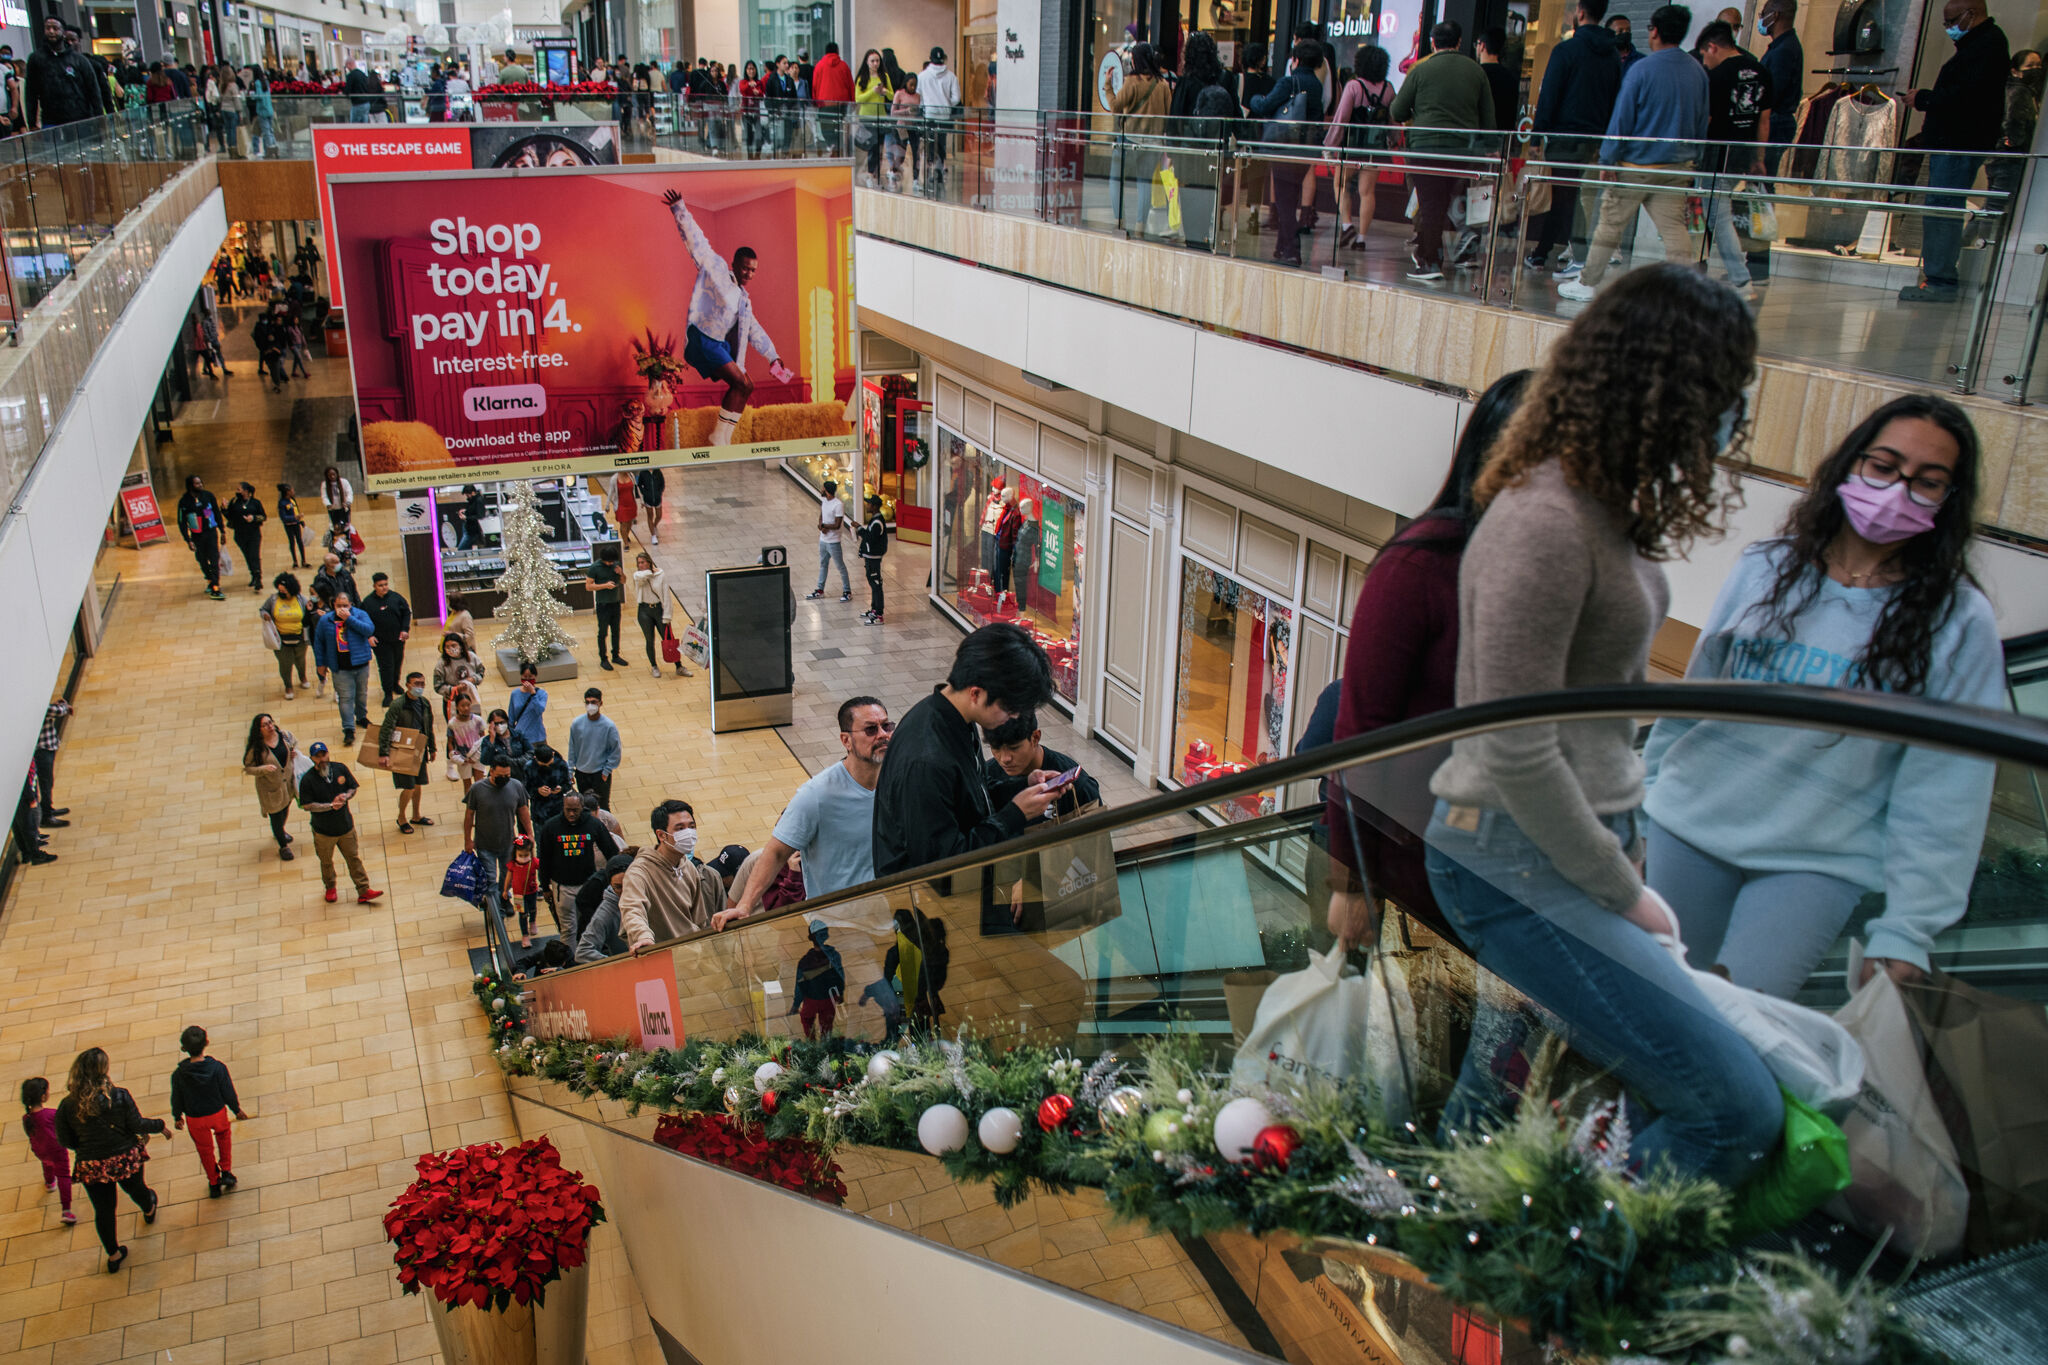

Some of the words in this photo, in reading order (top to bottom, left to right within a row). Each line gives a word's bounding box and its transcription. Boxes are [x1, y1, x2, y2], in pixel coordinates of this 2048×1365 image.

[341, 143, 369, 156] THE
[371, 143, 423, 155] ESCAPE
[425, 142, 462, 154] GAME
[430, 216, 541, 259] Shop
[427, 257, 558, 300] today,
[412, 309, 489, 350] pay
[497, 299, 536, 337] in
[543, 298, 582, 334] 4.
[433, 350, 569, 375] Interest-free.
[472, 395, 538, 412] Klarna.
[444, 433, 514, 450] Download
[517, 431, 541, 445] the
[545, 430, 571, 445] app
[692, 451, 710, 460] VANS
[751, 446, 781, 454] EXPRESS
[532, 464, 572, 473] SEPHORA
[629, 456, 649, 465] Locker
[375, 476, 407, 486] Available
[408, 475, 415, 483] at
[417, 473, 437, 482] these
[437, 471, 467, 481] retailers
[467, 470, 481, 478] and
[1058, 872, 1097, 897] adidas
[640, 1003, 671, 1036] Klarna.
